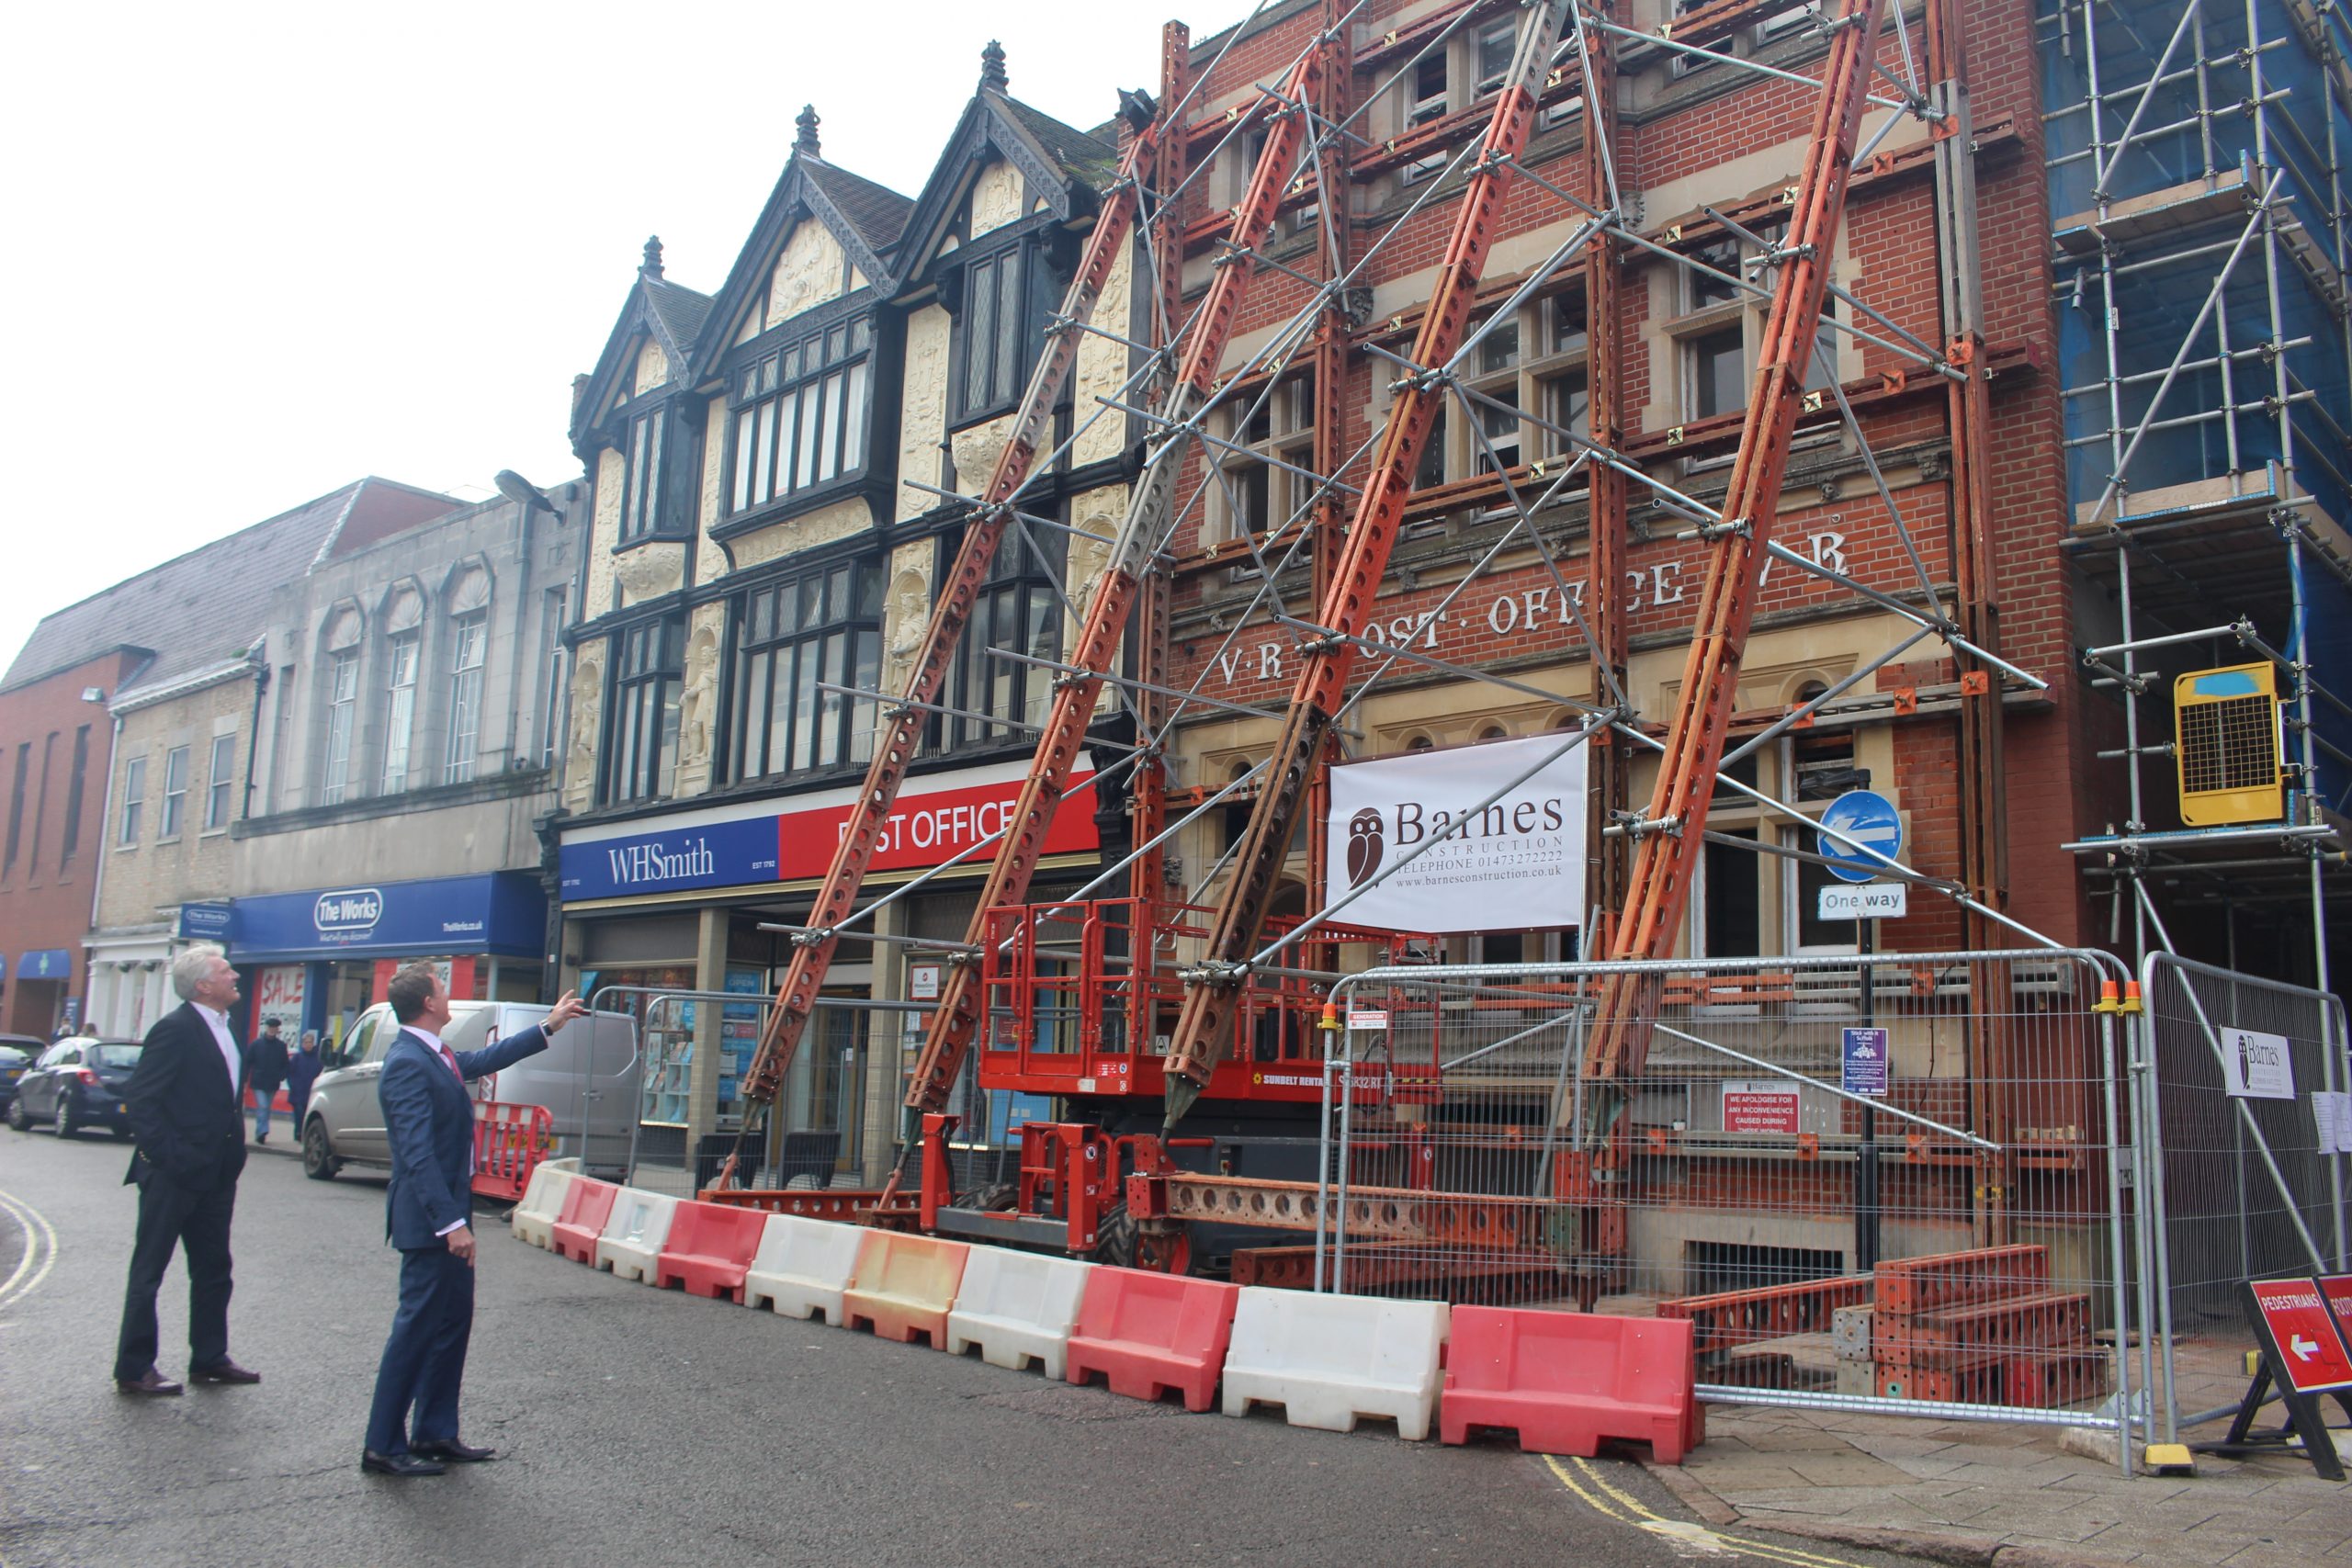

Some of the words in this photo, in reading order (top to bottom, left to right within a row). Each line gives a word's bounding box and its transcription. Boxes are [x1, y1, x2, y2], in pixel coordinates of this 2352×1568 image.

[1393, 797, 1564, 846] Barnes
[1396, 835, 1563, 862] CNSTRUCTION
[1478, 849, 1563, 868] 01473272222
[607, 837, 715, 885] WHSmith
[1396, 864, 1563, 888] www.barnesconstruction.co.uk
[320, 899, 340, 922] The
[341, 897, 378, 920] Works
[1826, 894, 1859, 908] One
[1865, 894, 1900, 908] way
[262, 973, 303, 1005] SALE
[2247, 1035, 2279, 1066] Barnes
[1263, 1075, 1298, 1086] SUNBELT
[1741, 1096, 1778, 1104] APOLOGISE
[1779, 1096, 1792, 1104] FOR
[1742, 1106, 1794, 1115] INCONVENIENCE
[1761, 1117, 1787, 1125] DURING
[2261, 1292, 2321, 1312] PEDESTRIANS
